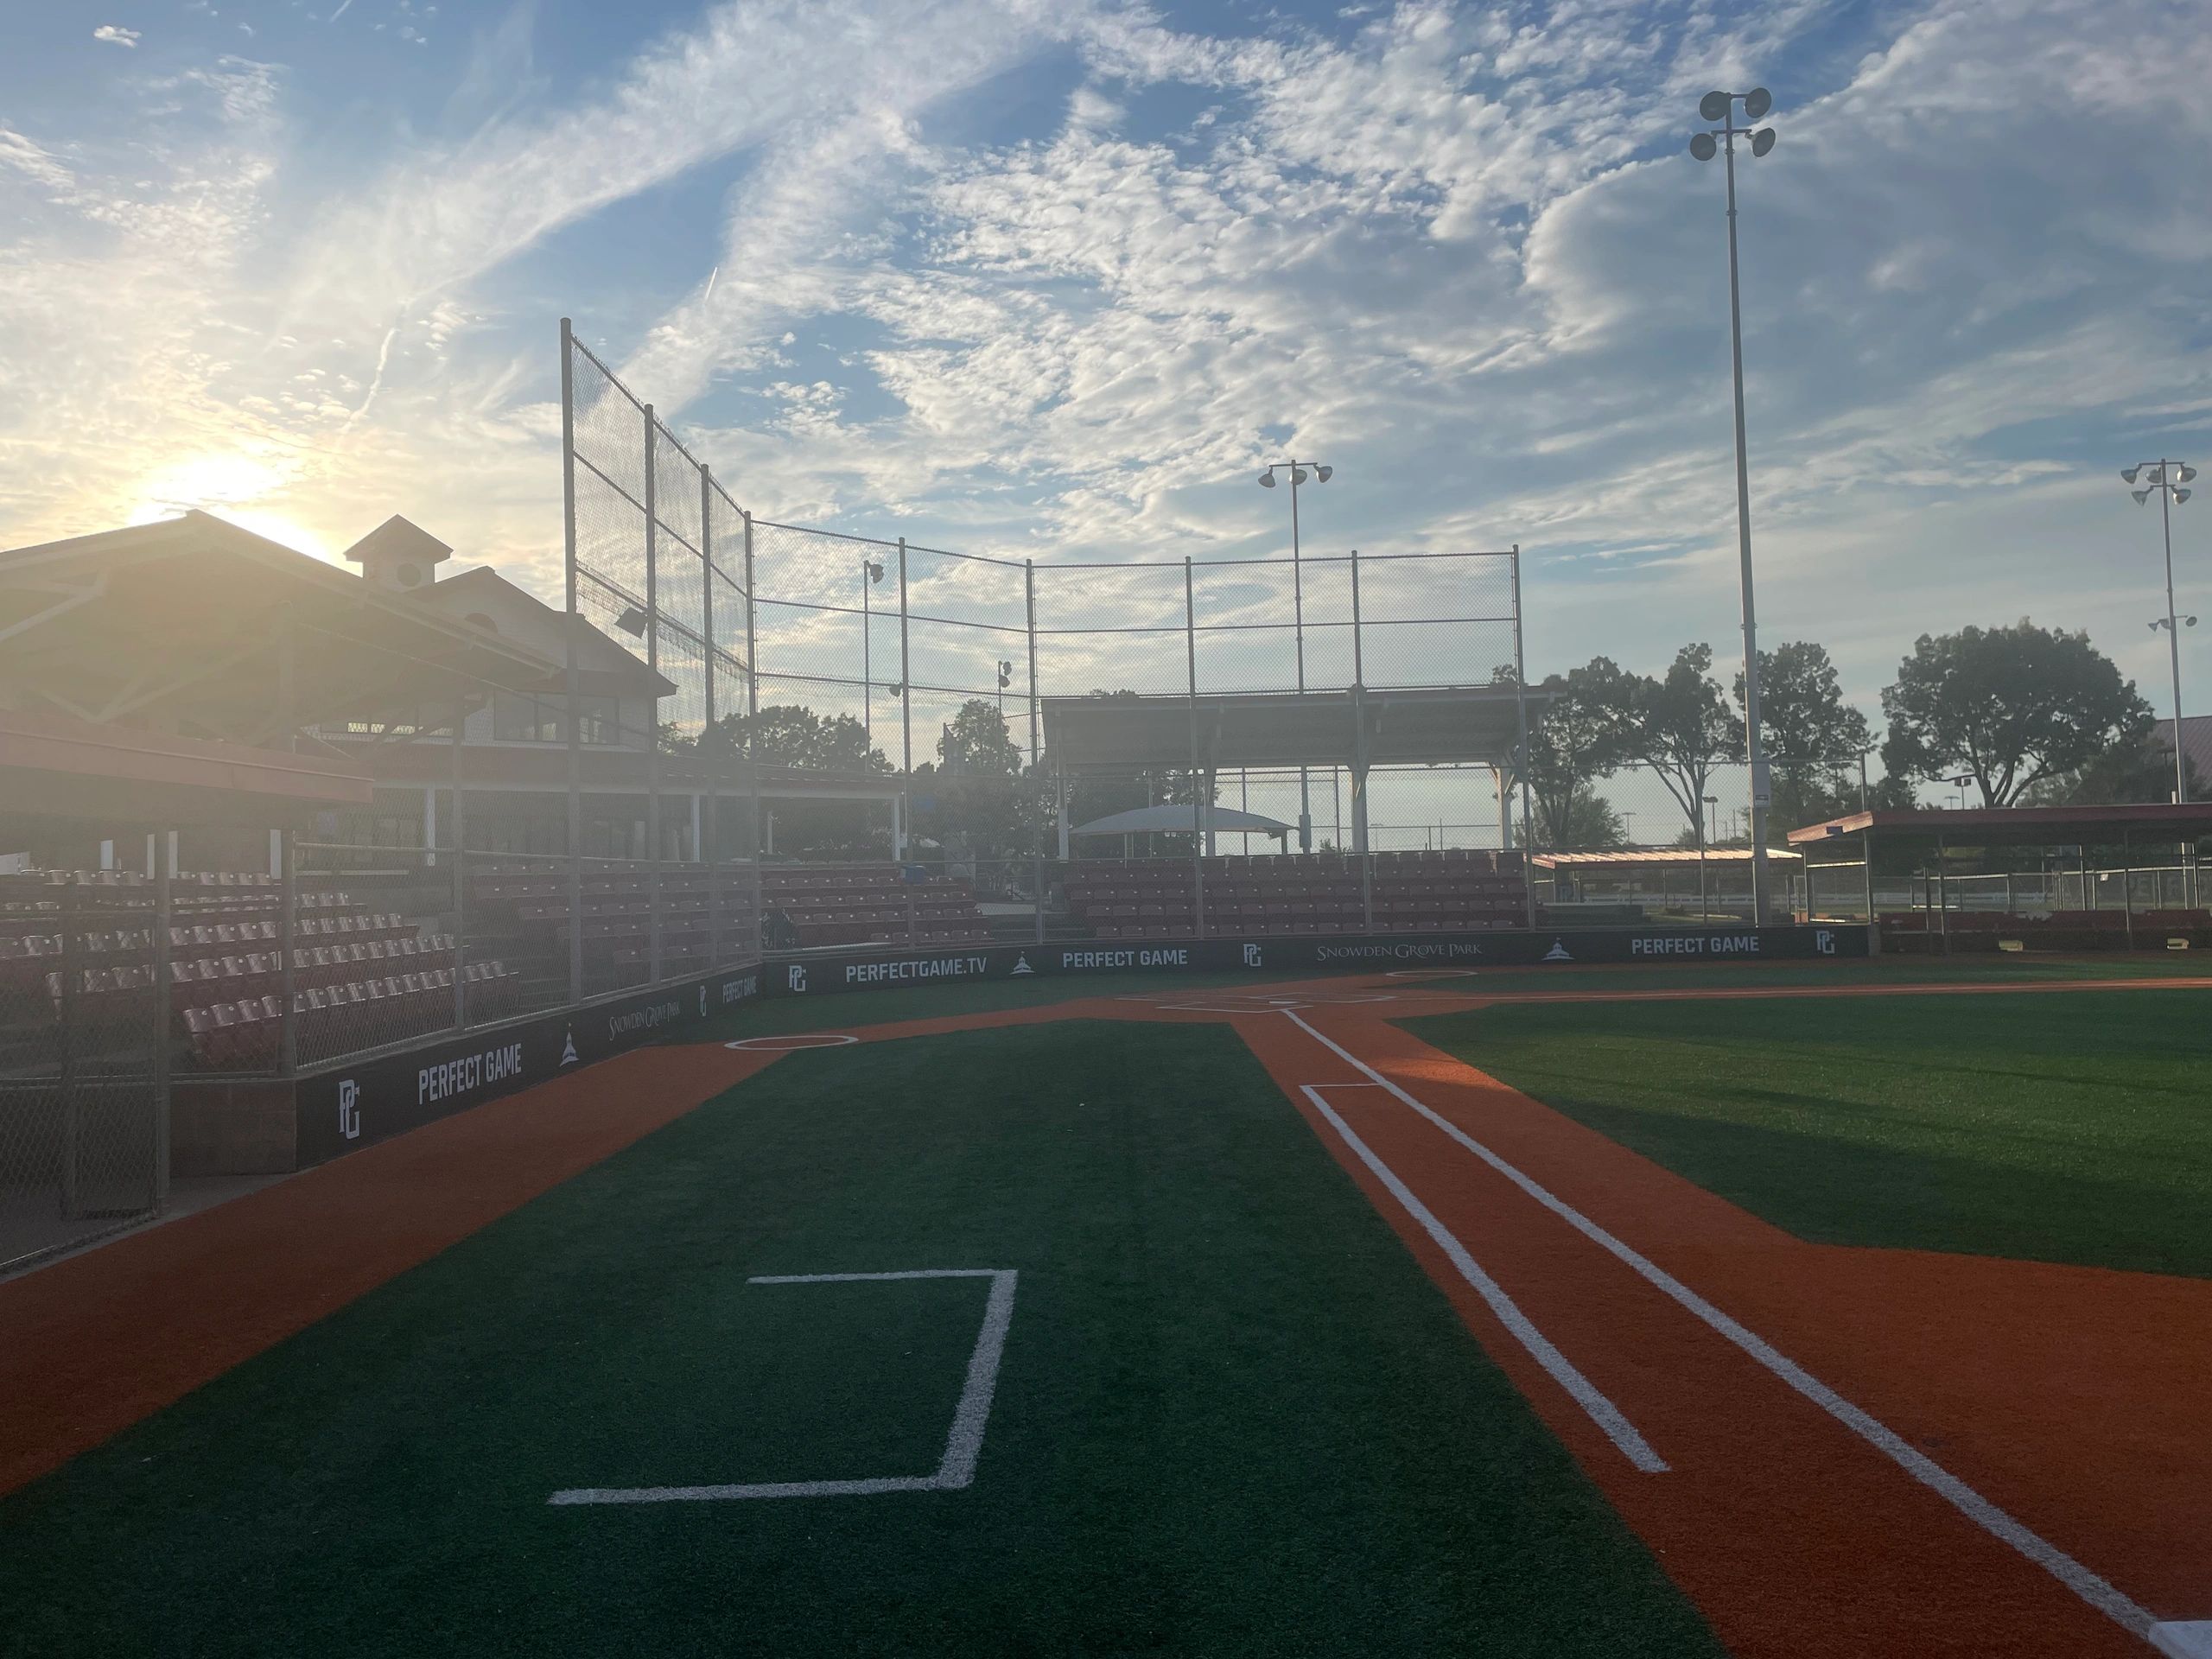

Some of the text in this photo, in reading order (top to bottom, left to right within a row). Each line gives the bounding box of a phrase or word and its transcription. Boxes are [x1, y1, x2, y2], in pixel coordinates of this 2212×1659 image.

[1631, 936, 1760, 955] PERFECT GAME
[846, 957, 987, 982] PERFECTGAME.TV
[1063, 950, 1188, 968] PERFECT GAME
[418, 1043, 522, 1105] PERFECT GAME
